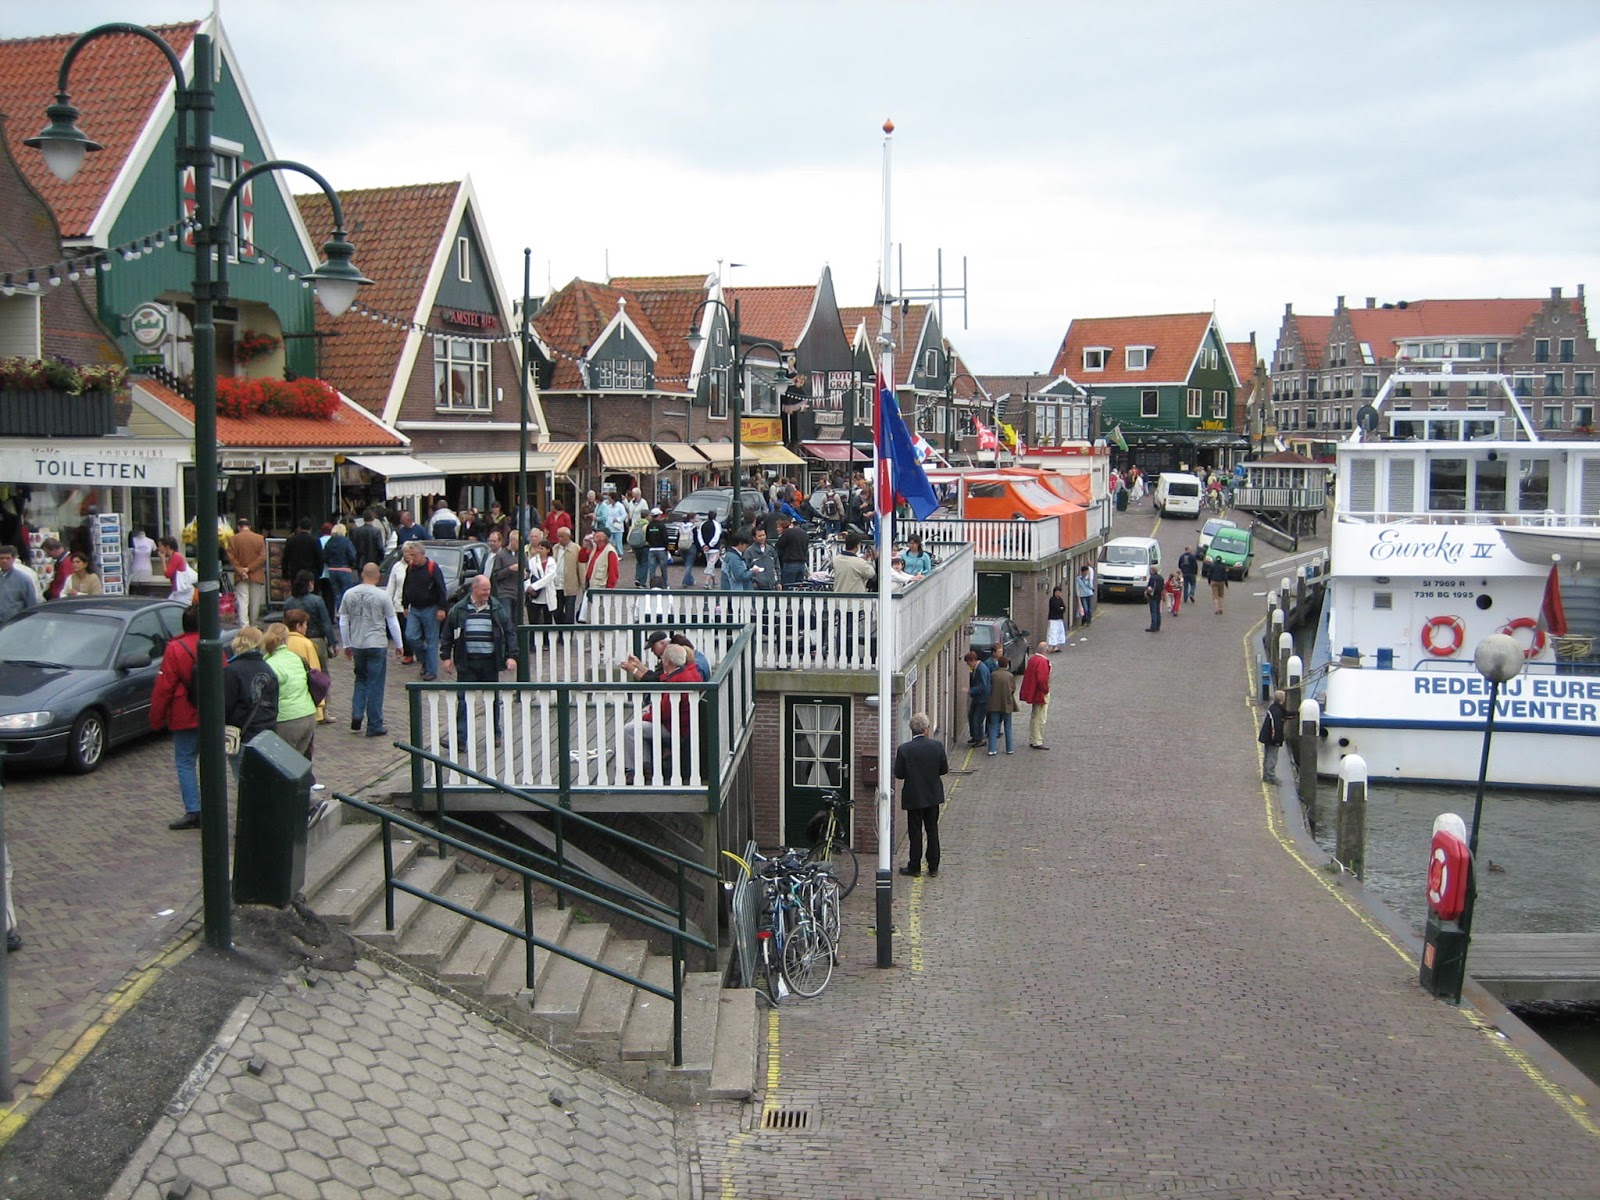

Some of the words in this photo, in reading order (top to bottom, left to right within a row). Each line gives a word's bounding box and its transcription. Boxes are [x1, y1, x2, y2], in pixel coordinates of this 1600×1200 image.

[450, 310, 480, 327] AMSTEL
[35, 459, 147, 479] TOILETTEN
[1369, 528, 1465, 565] Eureka
[1470, 543, 1497, 558] IV
[1452, 591, 1475, 599] 1995
[1533, 679, 1600, 700] EURE
[1459, 699, 1597, 721] DEVENTER
